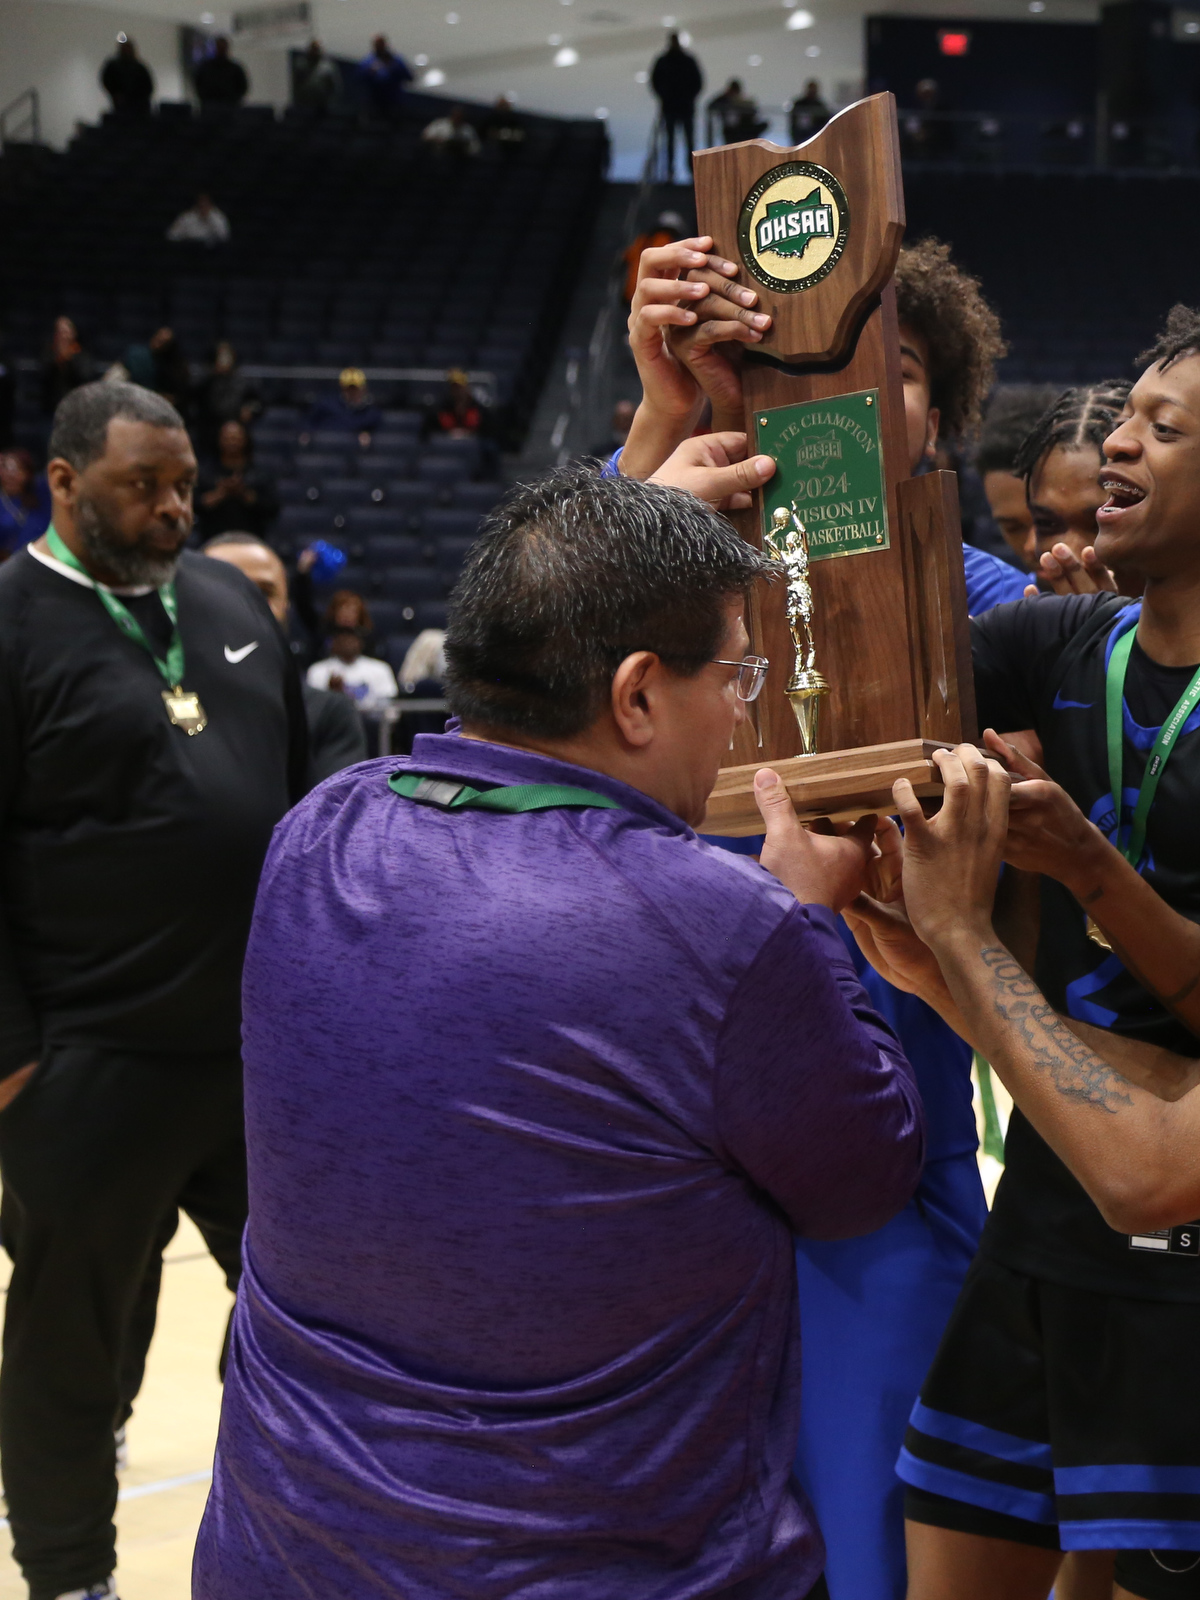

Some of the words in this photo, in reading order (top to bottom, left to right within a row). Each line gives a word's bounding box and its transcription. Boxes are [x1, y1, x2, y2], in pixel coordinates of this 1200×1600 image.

[760, 208, 830, 247] OHSAA
[767, 422, 800, 461] TATE
[801, 411, 877, 454] CHAMPION
[793, 472, 852, 501] 2024
[857, 496, 878, 514] IV
[1161, 699, 1191, 746] ASSOCIATION
[980, 947, 1043, 998] GOD
[1180, 1233, 1191, 1247] S
